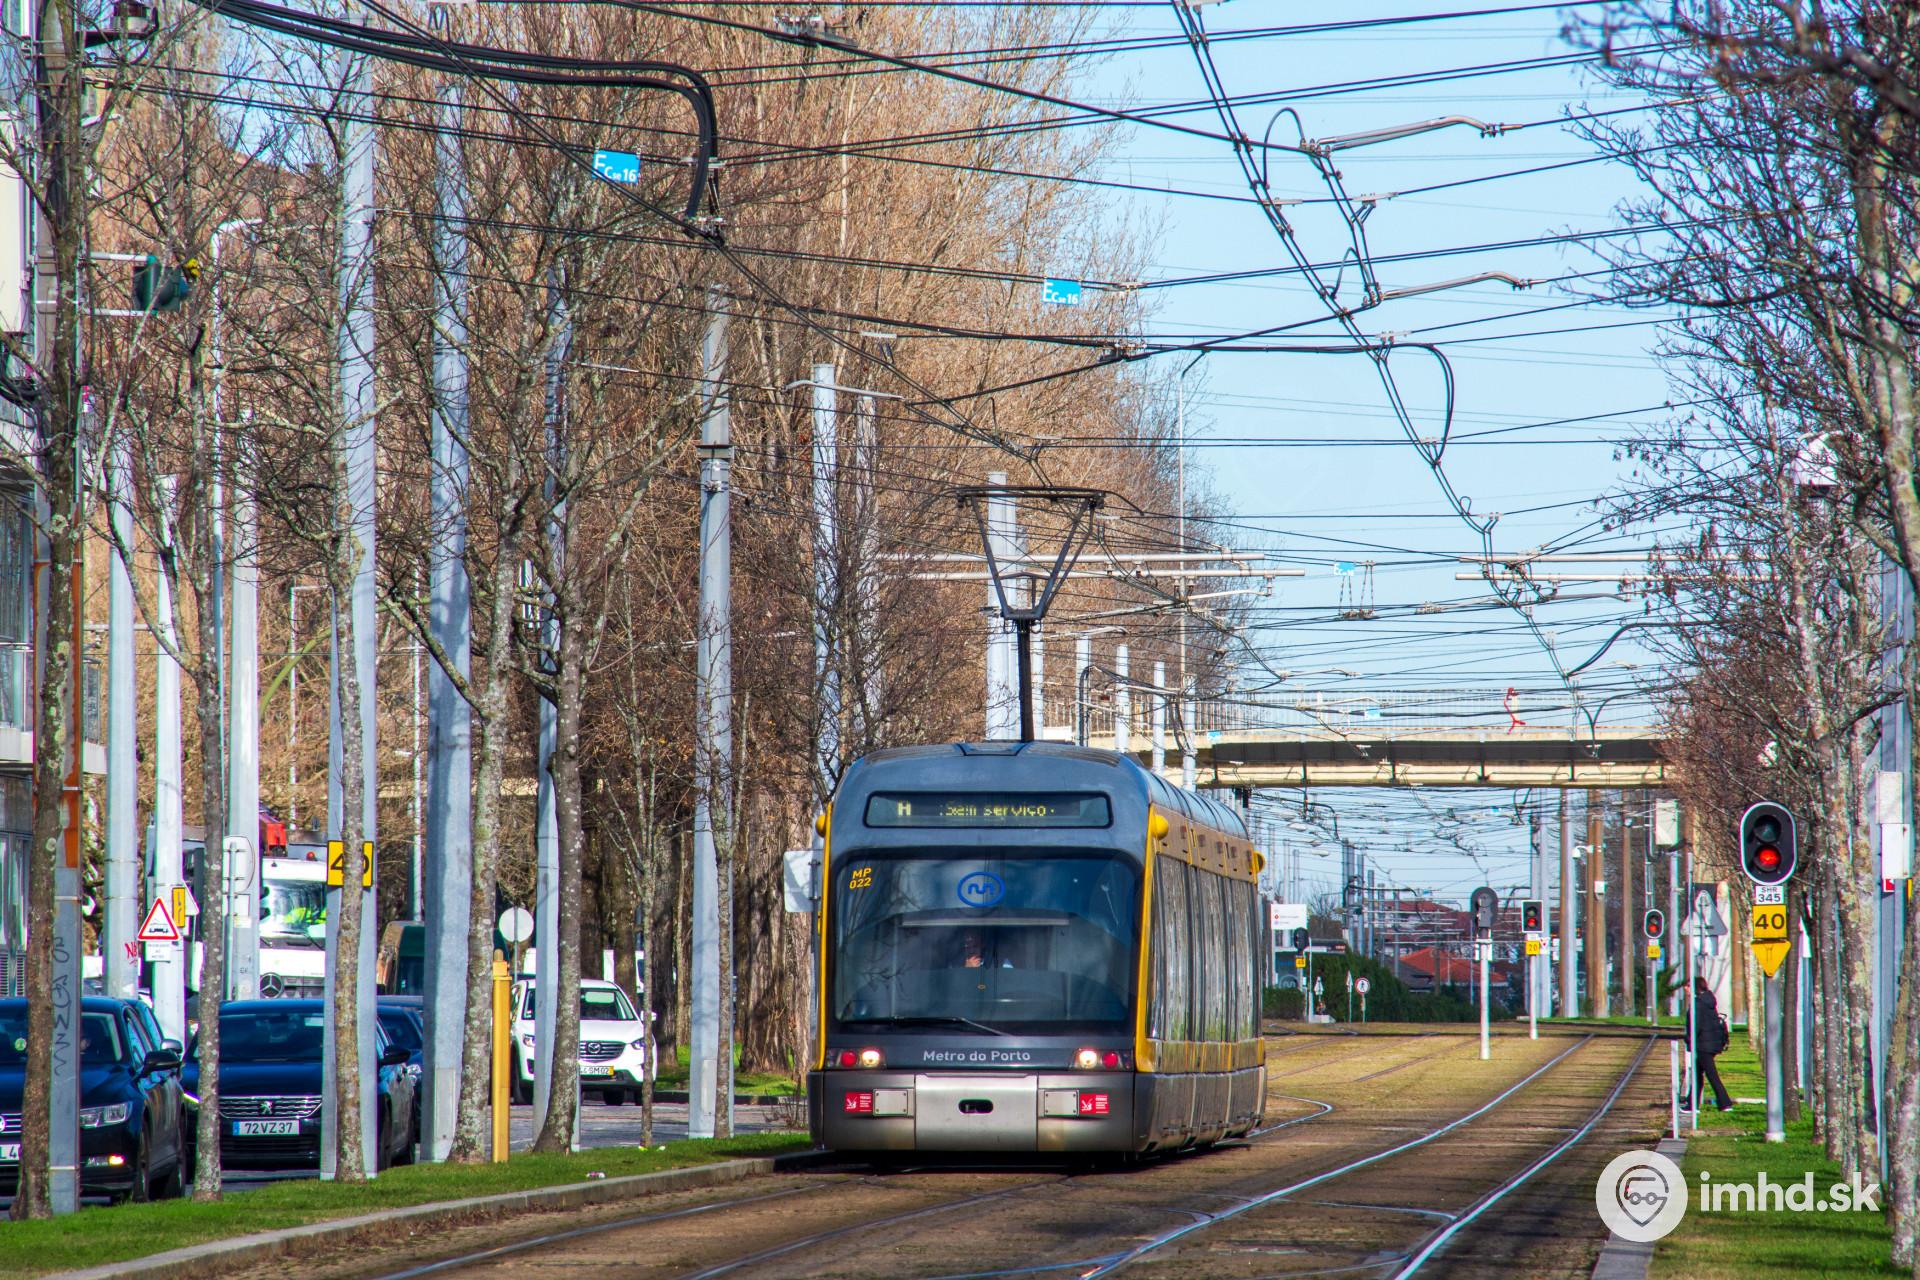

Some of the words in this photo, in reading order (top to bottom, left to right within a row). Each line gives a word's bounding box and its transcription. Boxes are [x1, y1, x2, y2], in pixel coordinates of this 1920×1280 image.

[852, 868, 872, 879] MP
[849, 877, 872, 889] 022
[1758, 893, 1781, 903] 345
[1755, 913, 1785, 930] 40
[923, 1050, 966, 1061] Metro
[969, 1050, 986, 1061] do
[991, 1050, 1031, 1061] Porto
